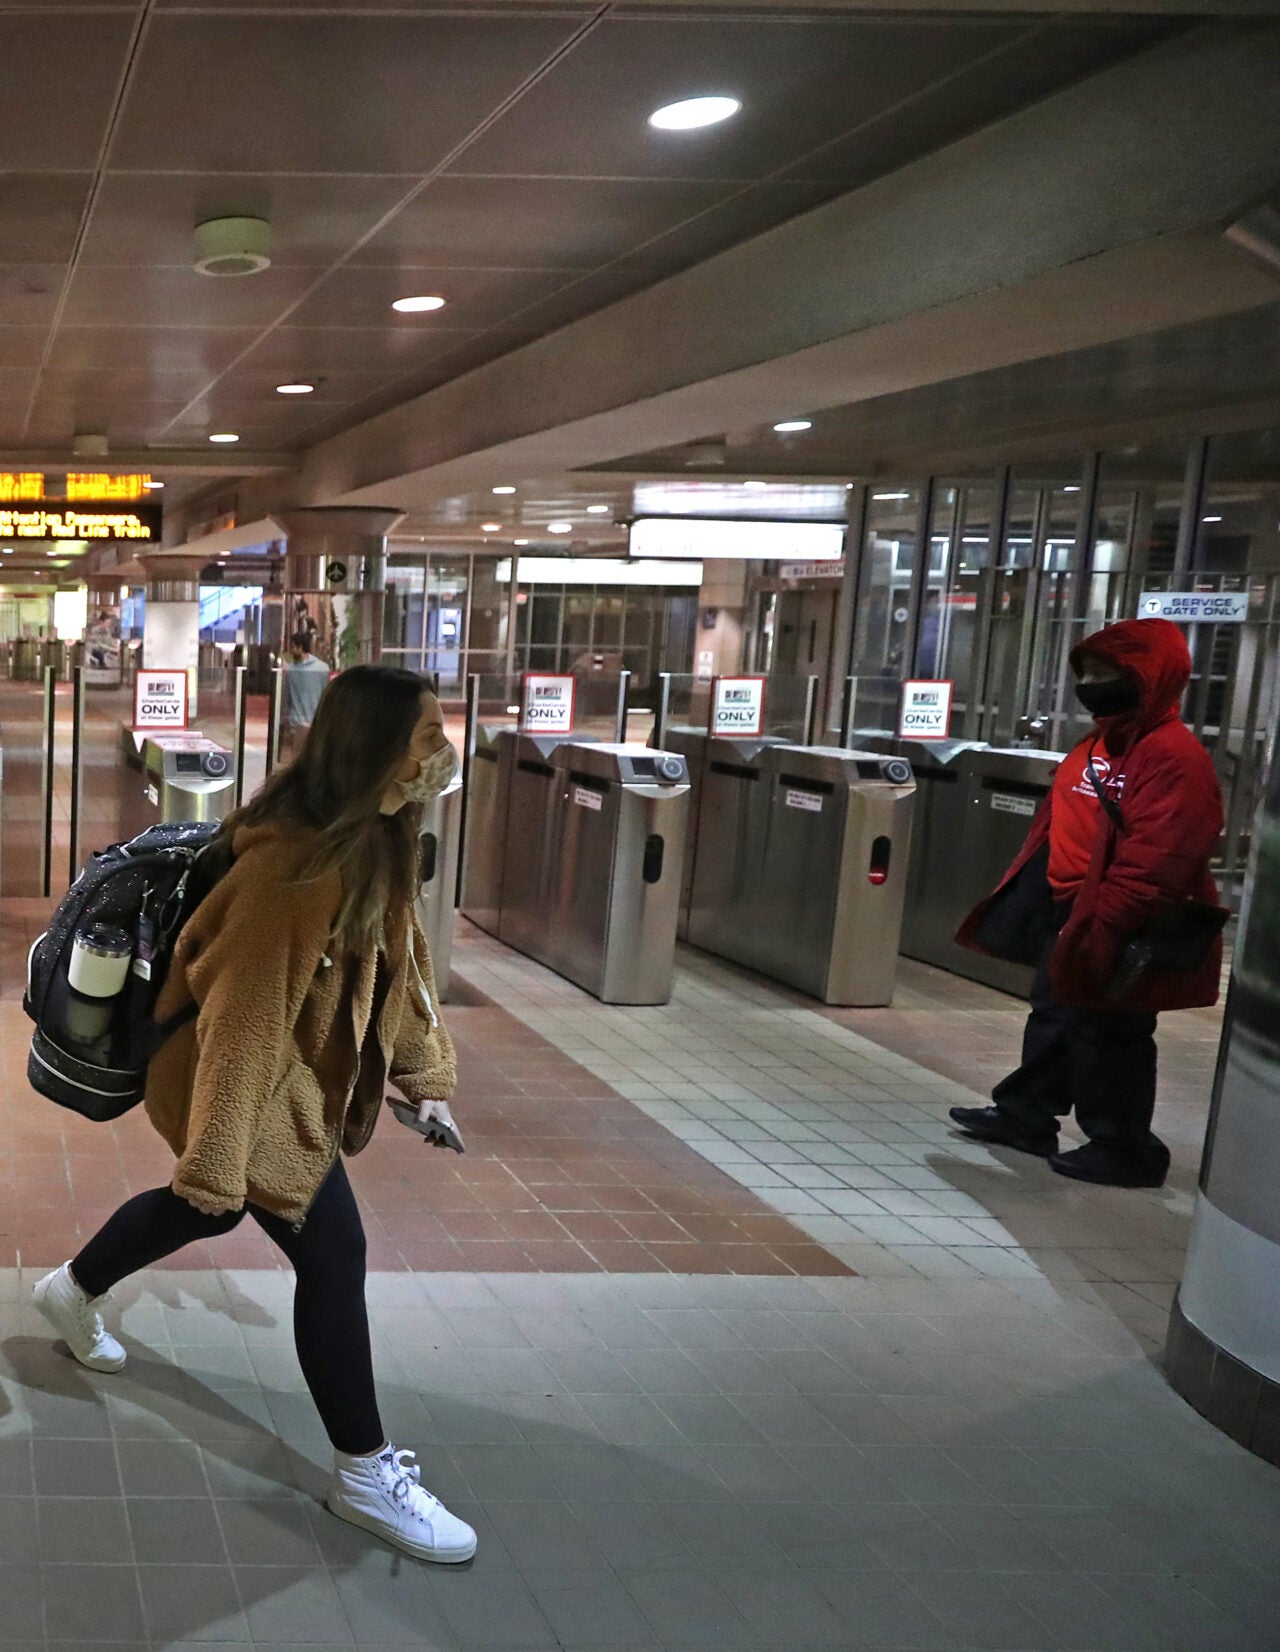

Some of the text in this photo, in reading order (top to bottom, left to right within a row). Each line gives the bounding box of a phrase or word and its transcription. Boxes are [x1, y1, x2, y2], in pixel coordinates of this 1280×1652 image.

[18, 525, 47, 537] next
[79, 525, 109, 538] Line
[113, 525, 150, 538] Train
[1172, 598, 1233, 607] SERVICE
[1162, 607, 1240, 616] GATE ONLY
[141, 704, 180, 714] ONLY
[527, 708, 566, 718] ONLY
[717, 711, 755, 721] ONLY
[905, 714, 942, 724] ONLY
